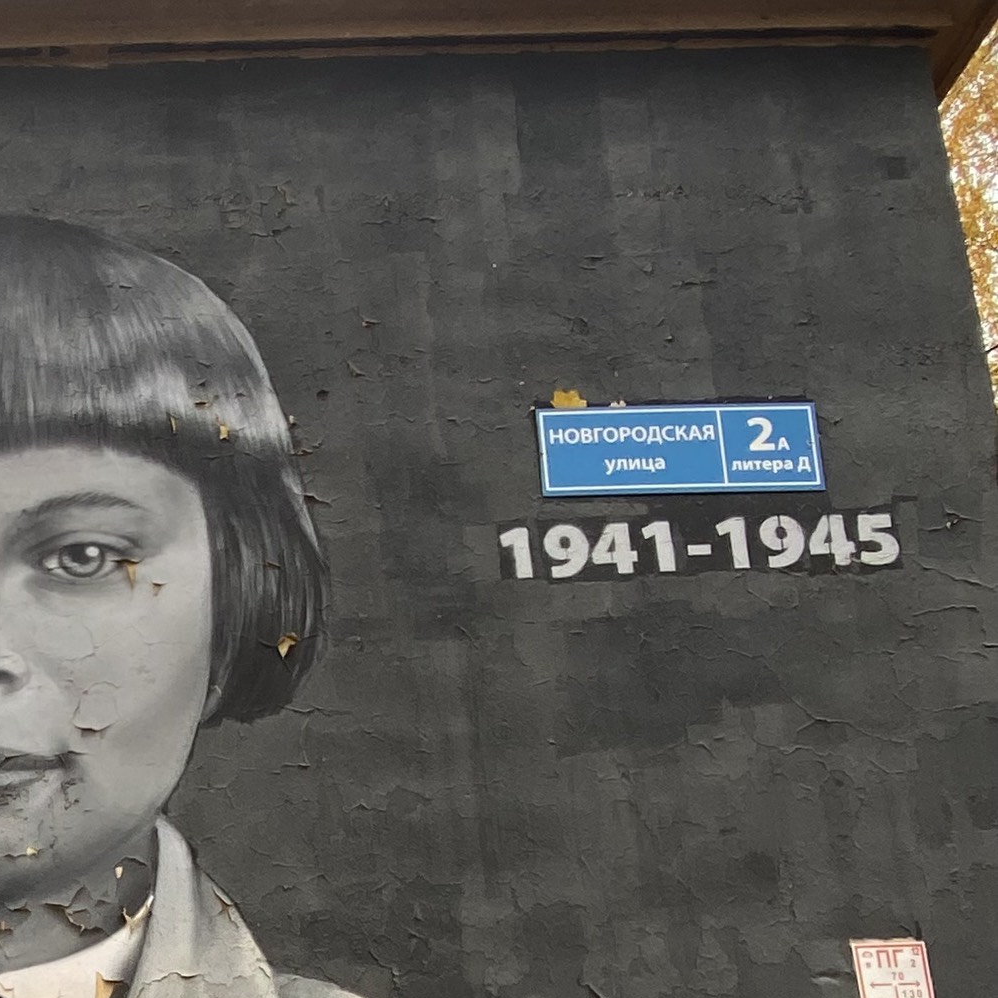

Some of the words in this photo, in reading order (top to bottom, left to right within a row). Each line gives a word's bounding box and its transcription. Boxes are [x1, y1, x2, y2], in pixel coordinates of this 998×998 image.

[548, 424, 715, 445] НОВГОРОДСКАЯ
[604, 456, 666, 474] улица
[731, 458, 793, 473] литера
[797, 456, 812, 473] Д
[499, 513, 900, 579] 1941-1945
[876, 950, 903, 968] ПГ
